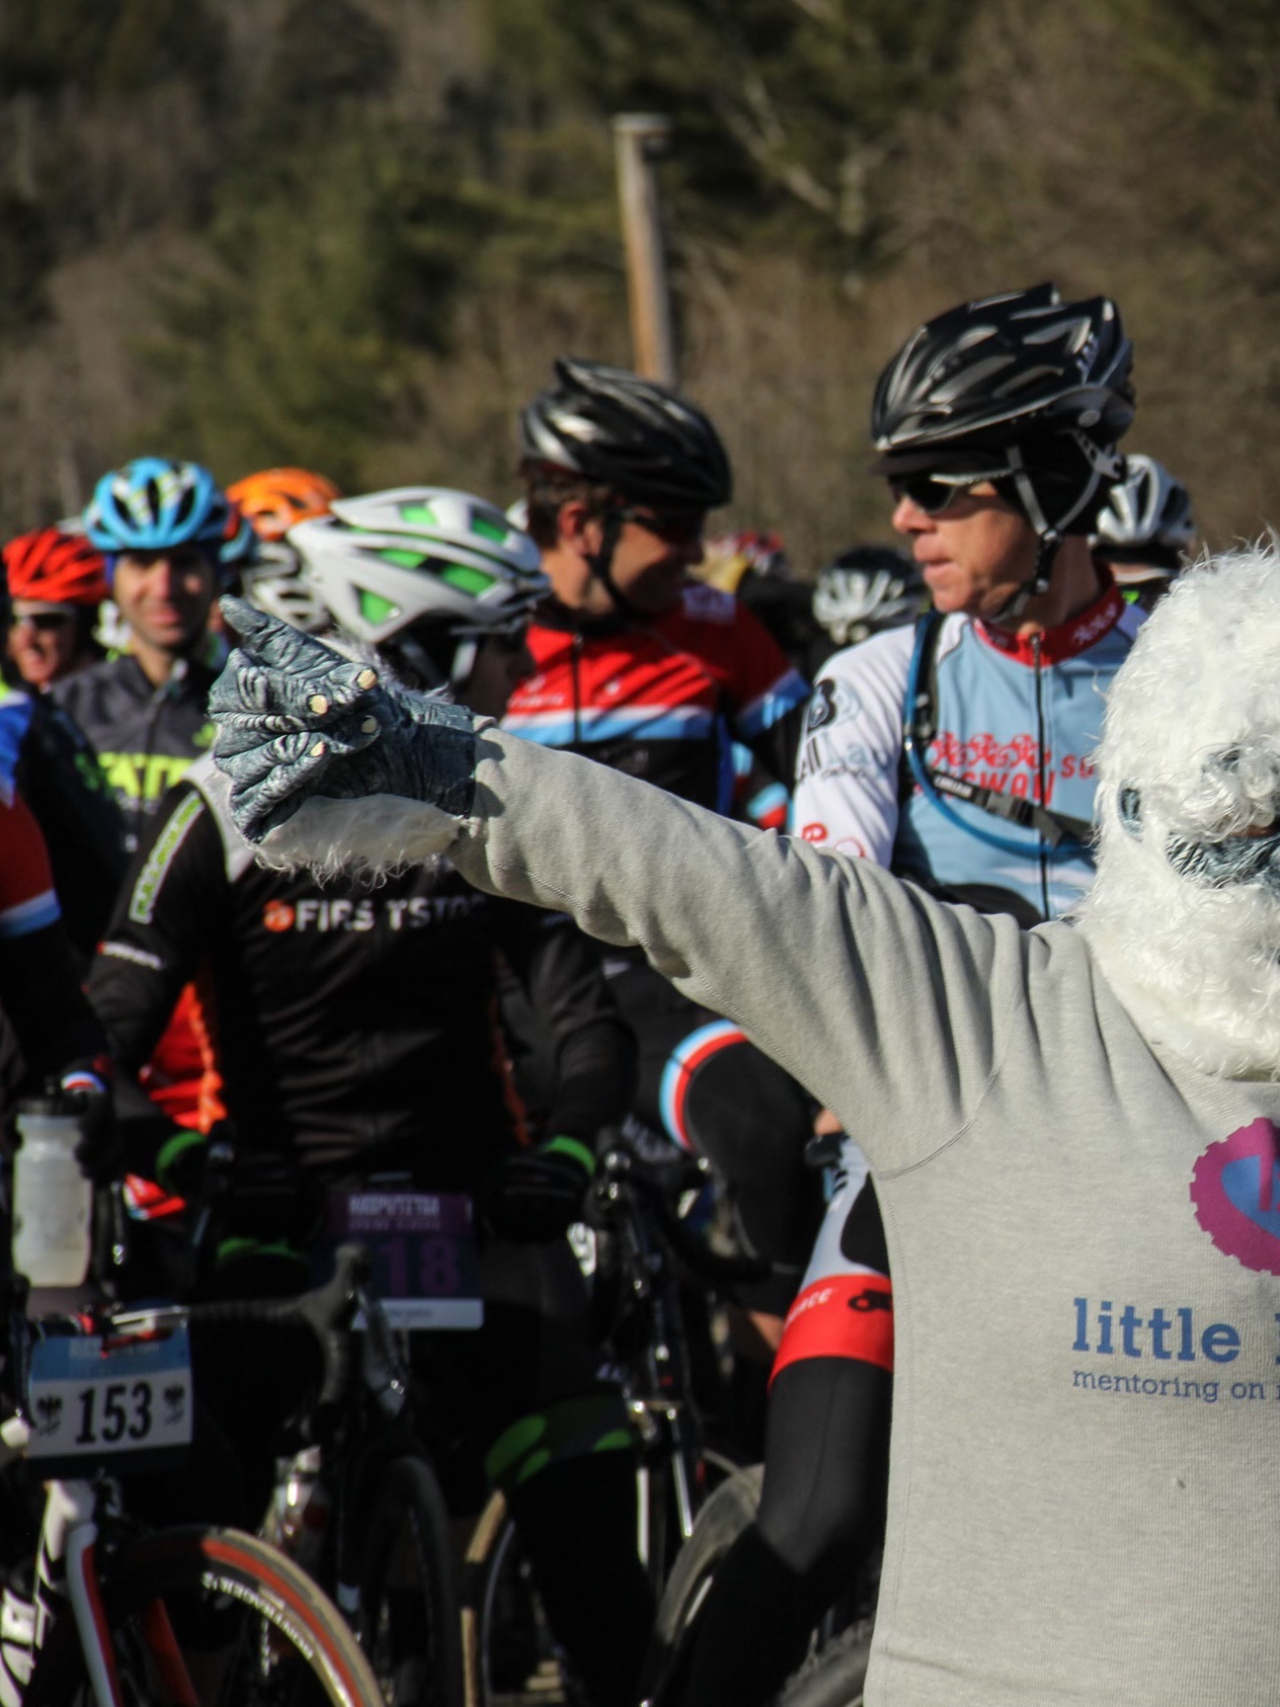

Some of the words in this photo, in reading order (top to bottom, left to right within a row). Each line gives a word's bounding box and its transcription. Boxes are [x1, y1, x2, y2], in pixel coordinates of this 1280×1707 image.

[1072, 1297, 1241, 1363] little
[76, 1381, 153, 1446] 153
[1072, 1369, 1220, 1402] mentoring
[1230, 1377, 1266, 1400] on
